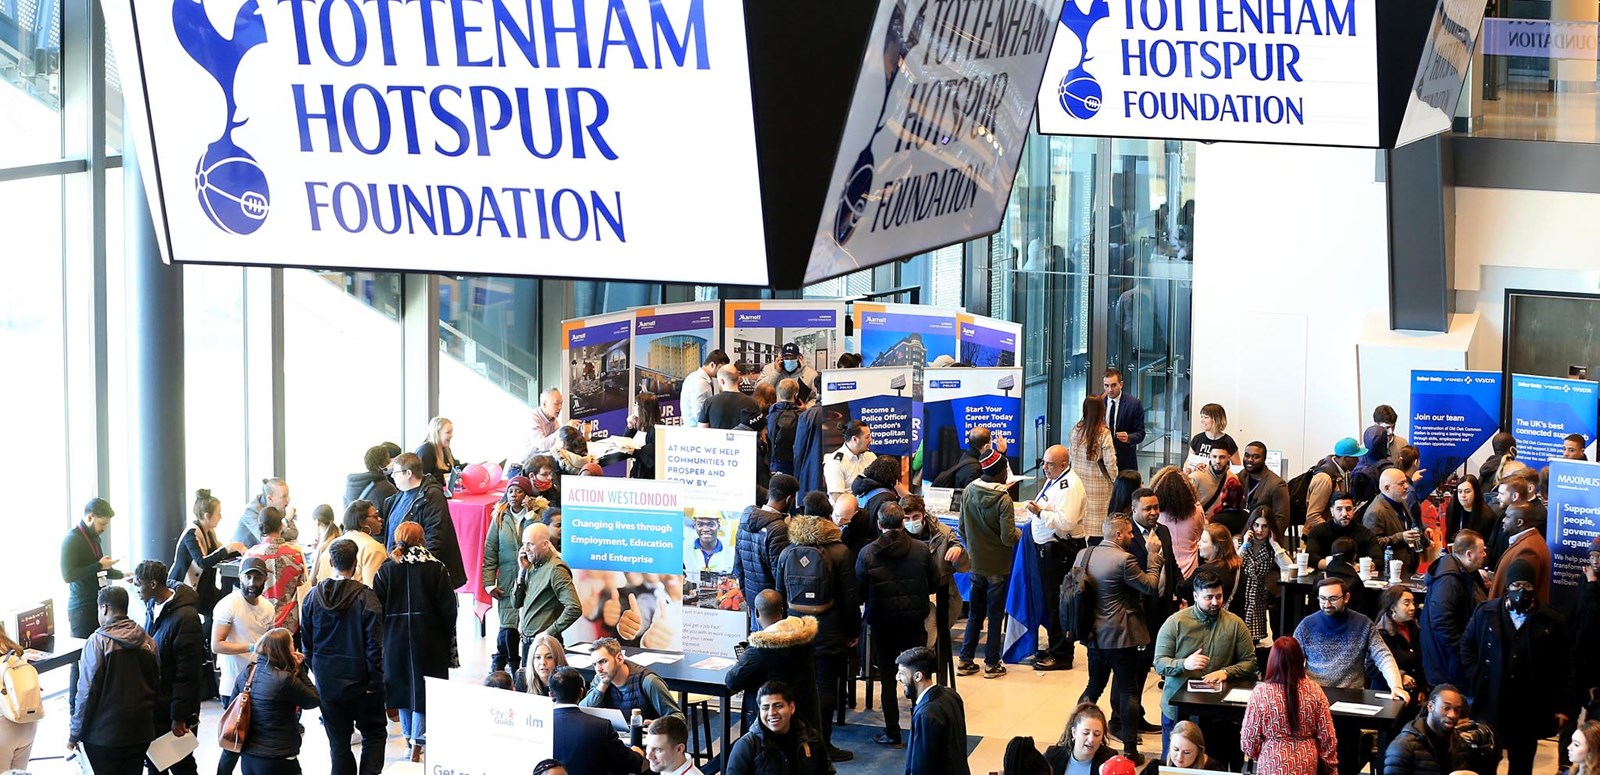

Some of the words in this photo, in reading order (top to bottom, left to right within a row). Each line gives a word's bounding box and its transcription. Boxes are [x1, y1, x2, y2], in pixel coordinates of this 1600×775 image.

[1124, 0, 1357, 37] TOTTENHAM
[277, 0, 710, 70] TOTTENHAM
[922, 0, 1050, 65] TOTTENHAM
[1121, 39, 1303, 82] HOTSPUR
[895, 72, 1008, 153] HOTSPUR
[1124, 91, 1304, 126] FOUNDATION
[291, 83, 619, 160] HOTSPUR
[871, 162, 986, 233] FOUNDATION
[304, 181, 627, 243] FOUNDATION
[1516, 418, 1529, 426] The
[1530, 420, 1547, 428] UK's
[1548, 422, 1565, 430] best
[870, 430, 906, 438] tropolitan
[1516, 428, 1552, 437] connected
[884, 437, 909, 445] Service
[668, 456, 725, 466] COMMUNITIES
[668, 467, 705, 475] PROSPER
[1557, 474, 1600, 486] MAXIMUS
[568, 488, 604, 503] ACTION
[1564, 503, 1600, 515] Supporti
[571, 519, 614, 531] Changing
[615, 521, 636, 530] lives
[637, 522, 672, 534] through
[1563, 516, 1595, 527] people,
[1562, 528, 1600, 537] governm
[570, 535, 628, 547] Employment,
[630, 538, 673, 549] Education
[1562, 539, 1592, 549] organi
[609, 553, 654, 565] Enterprise
[1565, 555, 1578, 563] help
[1553, 562, 1582, 570] transform
[1553, 571, 1580, 579] employm
